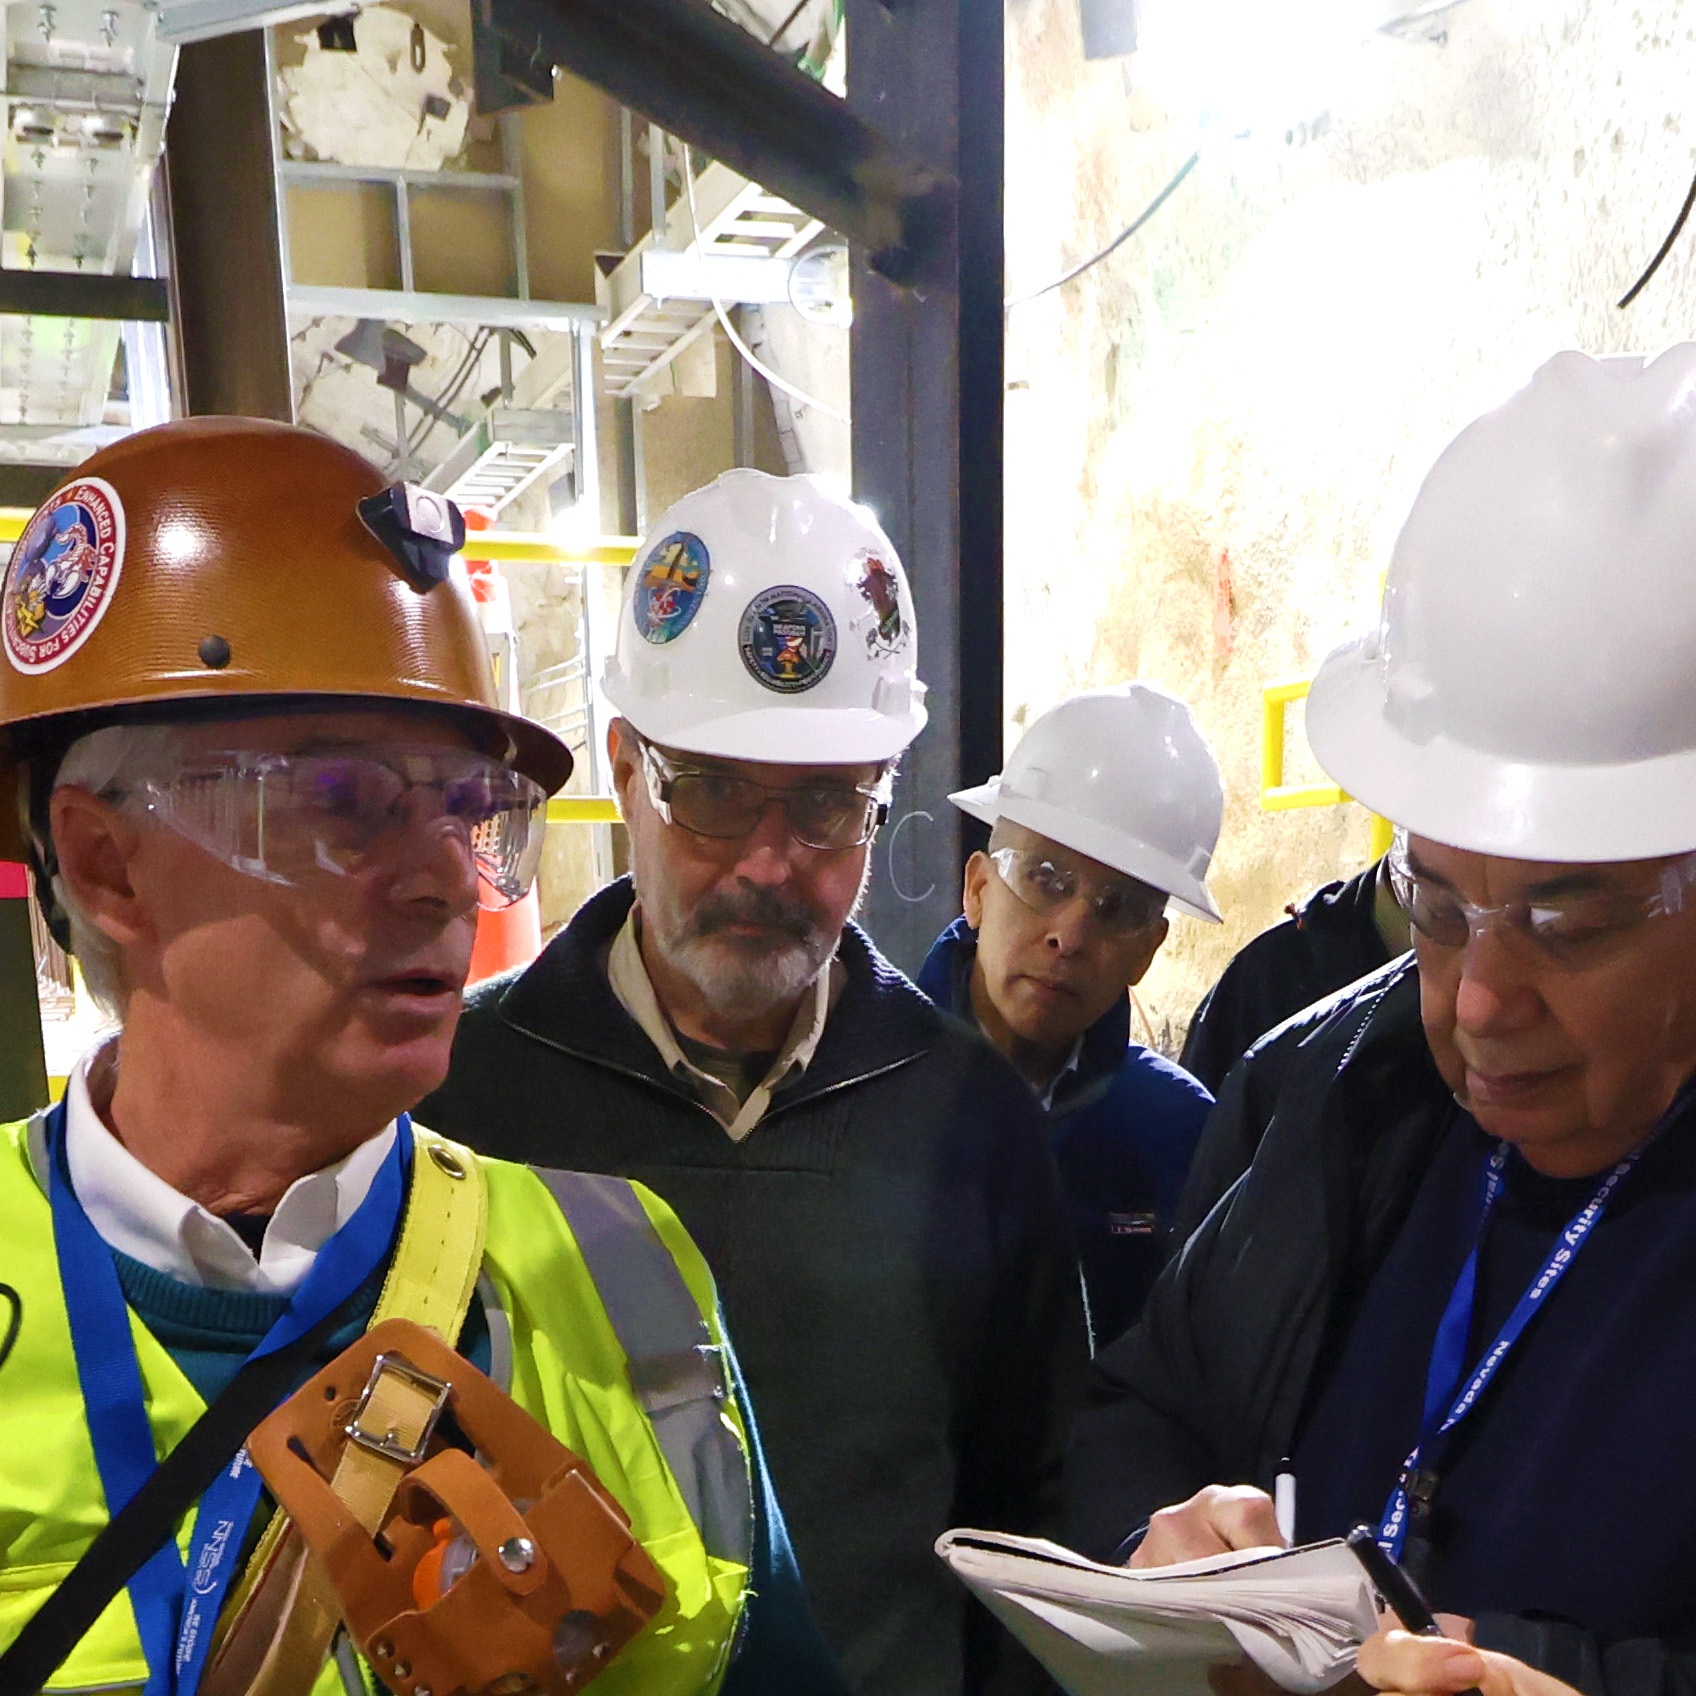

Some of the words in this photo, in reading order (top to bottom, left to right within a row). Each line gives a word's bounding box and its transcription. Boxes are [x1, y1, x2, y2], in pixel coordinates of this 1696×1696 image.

[73, 485, 114, 538] ENHANCED
[60, 543, 115, 649] CAPABILITIES
[37, 639, 61, 660] FOR
[1564, 1163, 1630, 1246] Security
[1529, 1247, 1573, 1300] Sites
[1454, 1340, 1510, 1414] Nevada
